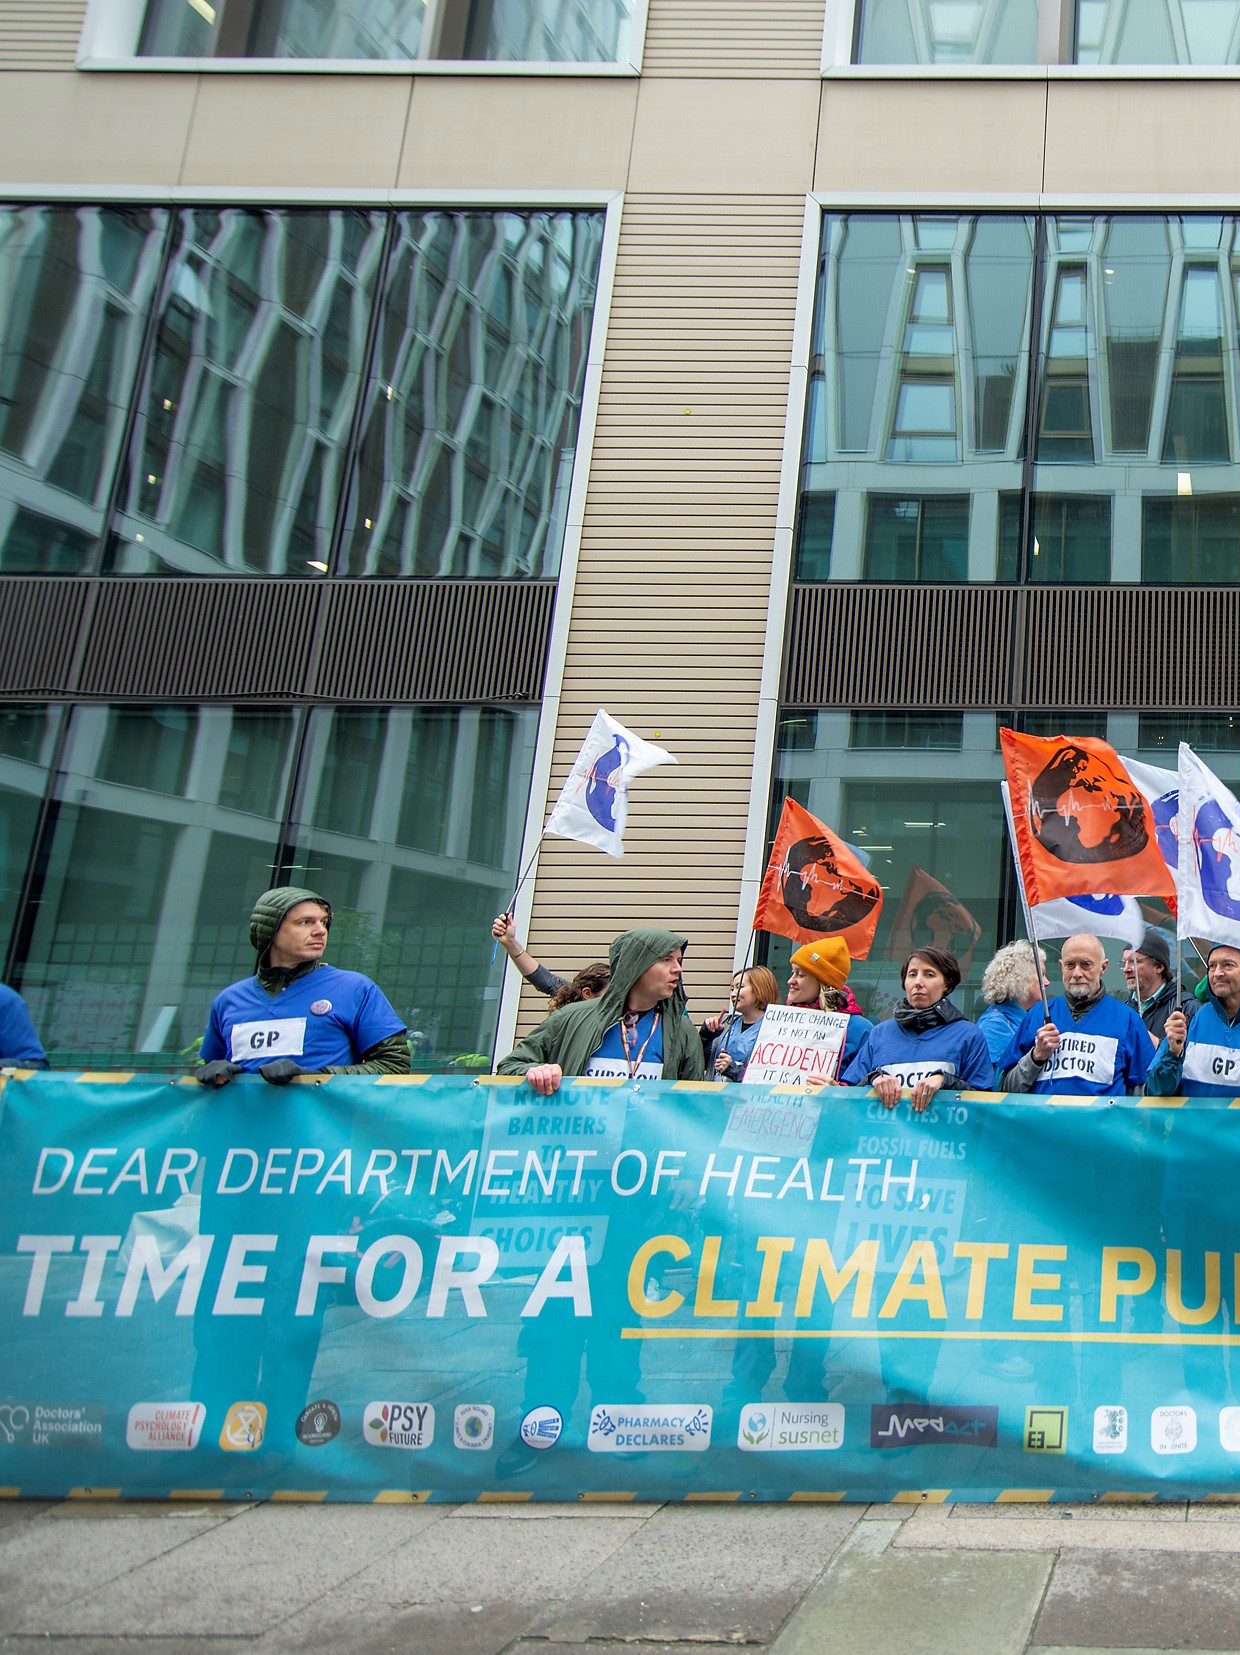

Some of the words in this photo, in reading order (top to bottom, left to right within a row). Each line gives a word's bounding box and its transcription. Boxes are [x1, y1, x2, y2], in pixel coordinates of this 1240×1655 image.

[765, 1010, 807, 1024] CLIMATE
[808, 1015, 847, 1029] CHANGE
[250, 1031, 280, 1049] GP
[778, 1027, 787, 1035] IS
[790, 1028, 811, 1039] NOT
[812, 1031, 826, 1040] AN
[1057, 1038, 1096, 1054] TIRED
[750, 1042, 839, 1075] ACCIDENT
[1044, 1056, 1095, 1074] DOCTOR
[1212, 1057, 1236, 1075] GP
[763, 1069, 777, 1081] IT
[779, 1071, 790, 1083] IS
[792, 1075, 801, 1085] A
[728, 1106, 819, 1142] EMERGENCY
[946, 1107, 969, 1125] TO
[508, 1117, 607, 1136] BARRIERS
[857, 1135, 912, 1157] FOSSIL
[917, 1140, 967, 1161] FUELS
[32, 1147, 199, 1196] DEAR
[216, 1147, 598, 1196] DEPARTMENT
[610, 1149, 687, 1196] OF
[699, 1153, 932, 1210] HEALTH,
[16, 1234, 276, 1318] TIME
[295, 1234, 499, 1319] FOR
[521, 1235, 593, 1318] A
[627, 1234, 1068, 1321] CLIMATE
[35, 1406, 86, 1419] Doctors'
[156, 1409, 192, 1420] CLIMATE
[389, 1404, 428, 1432] PSY
[780, 1411, 829, 1427] Nursing
[33, 1420, 102, 1433] Association
[134, 1420, 188, 1432] PSYCHOLOGY
[617, 1416, 687, 1428] PHARMACY
[33, 1433, 50, 1444] UK
[148, 1431, 186, 1441] ALLIANCE
[389, 1432, 423, 1446] FUTURE
[615, 1433, 685, 1446] DECLARES
[778, 1427, 839, 1445] susnet
